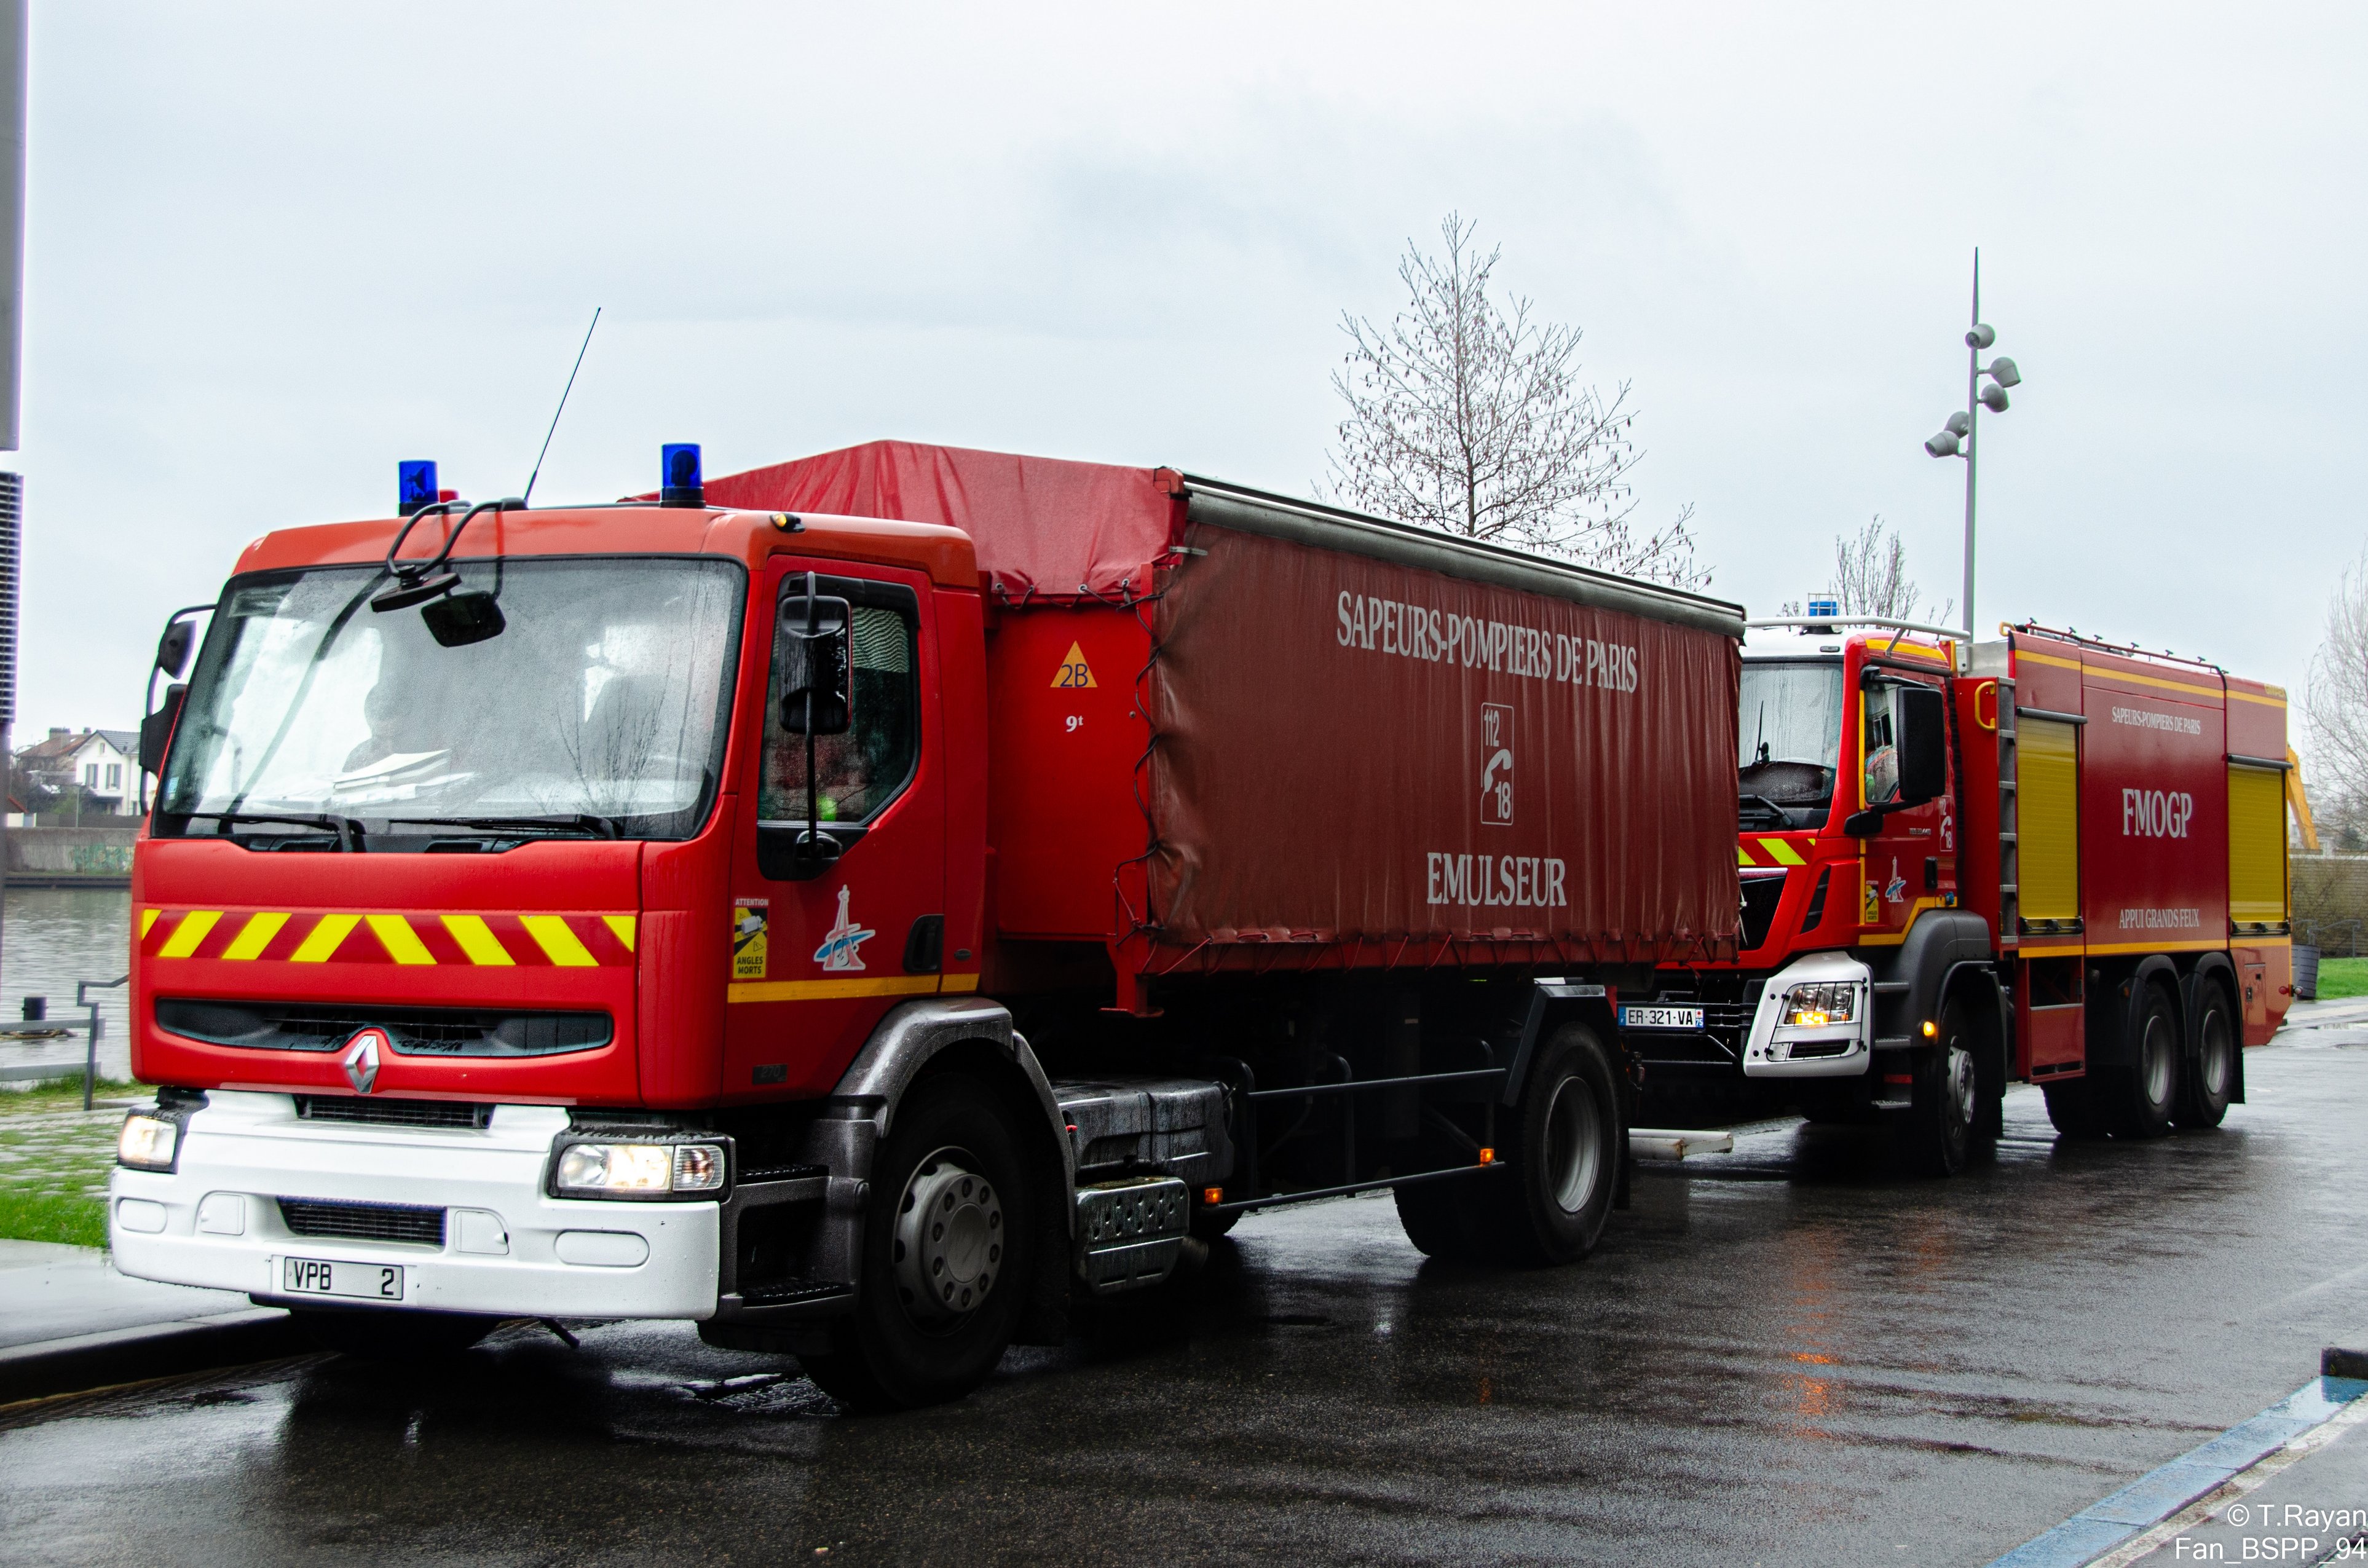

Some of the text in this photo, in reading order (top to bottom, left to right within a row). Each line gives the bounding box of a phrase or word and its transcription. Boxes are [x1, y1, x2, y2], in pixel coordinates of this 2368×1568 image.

[1336, 590, 1638, 693] SAPEURS-POMPIERS DE PARIS
[1060, 663, 1088, 687] 2B
[1483, 709, 1499, 747] 112
[2112, 706, 2201, 735] SAPEURS-POMPIERS DE PARIS
[1494, 781, 1512, 819] 18
[2122, 788, 2193, 838] FMOGP
[1945, 830, 1952, 848] 18
[1427, 852, 1568, 907] EMULSEUR
[2119, 908, 2200, 929] APPUI GRANDS FEUX
[738, 966, 762, 974] MORTS
[294, 1261, 394, 1295] VPB 2
